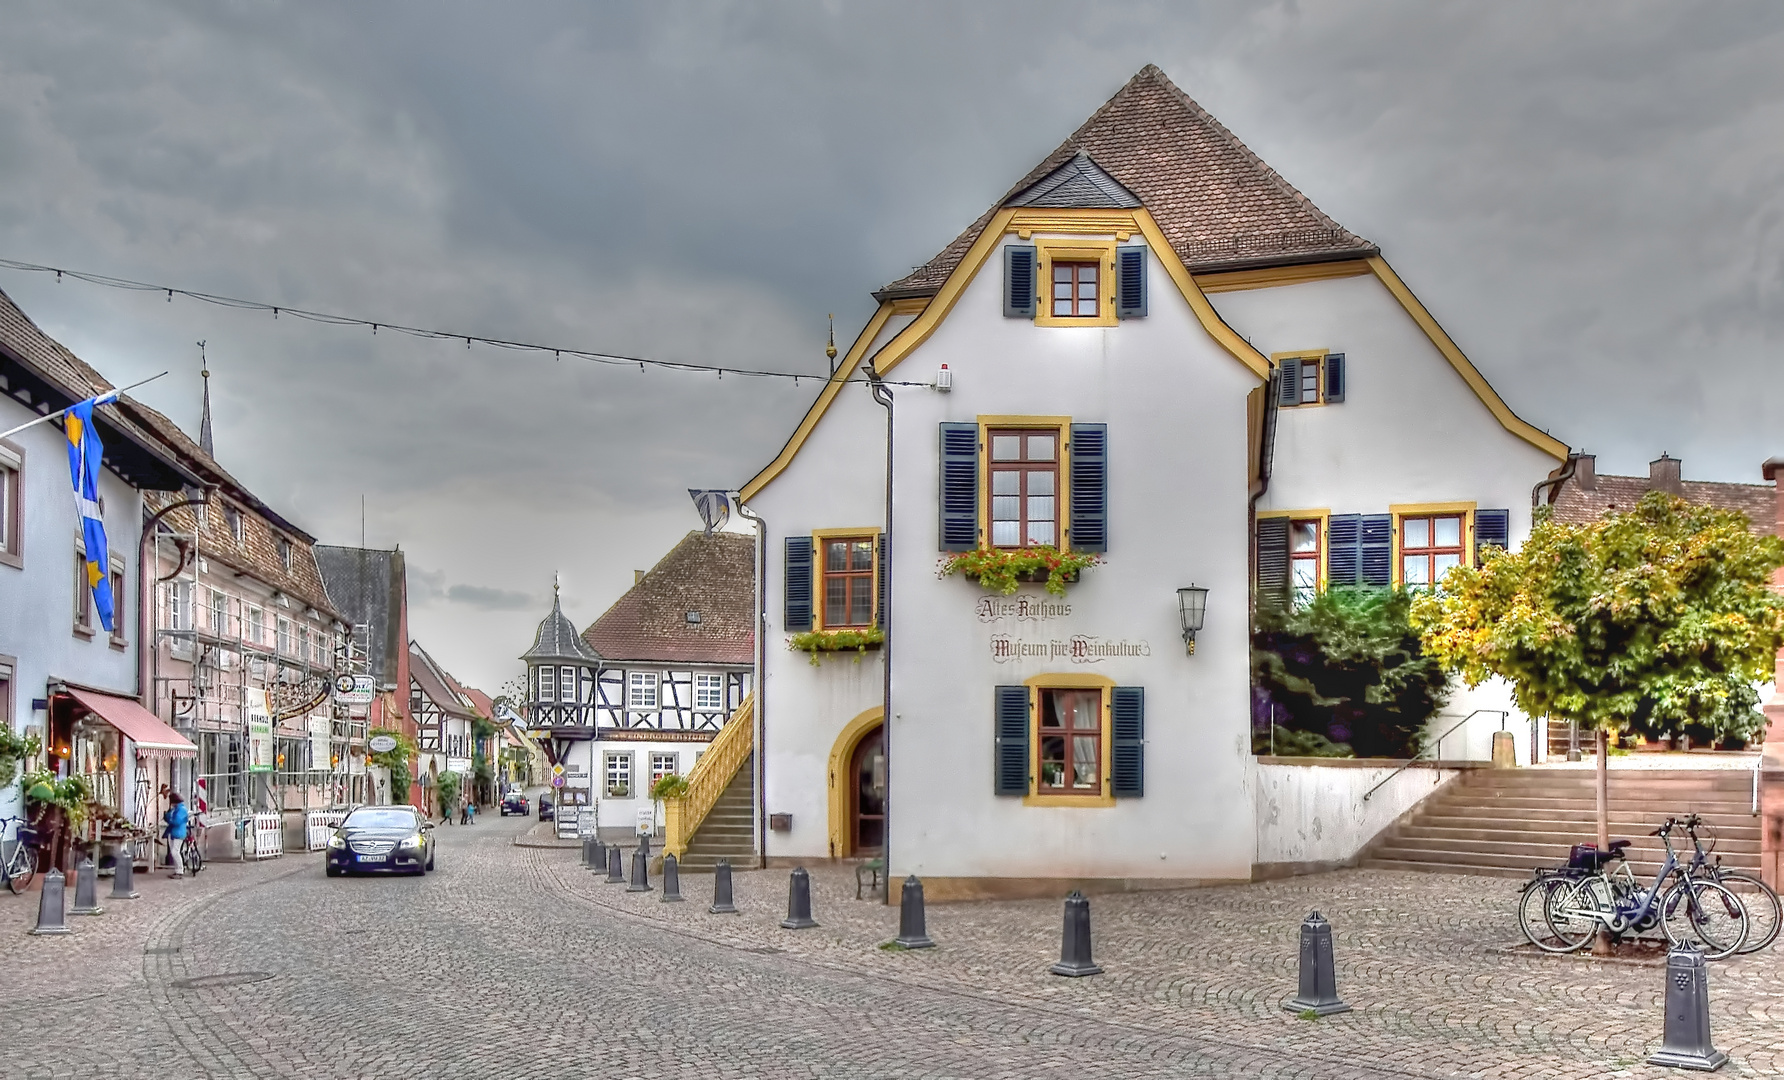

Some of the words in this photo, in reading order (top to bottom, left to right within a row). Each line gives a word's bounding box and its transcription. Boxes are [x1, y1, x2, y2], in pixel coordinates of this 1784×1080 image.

[977, 597, 1014, 620] Altes
[1016, 597, 1072, 620] Rathaus
[991, 635, 1047, 661] Museum
[1050, 639, 1068, 661] für
[1070, 636, 1147, 661] Weinkultur
